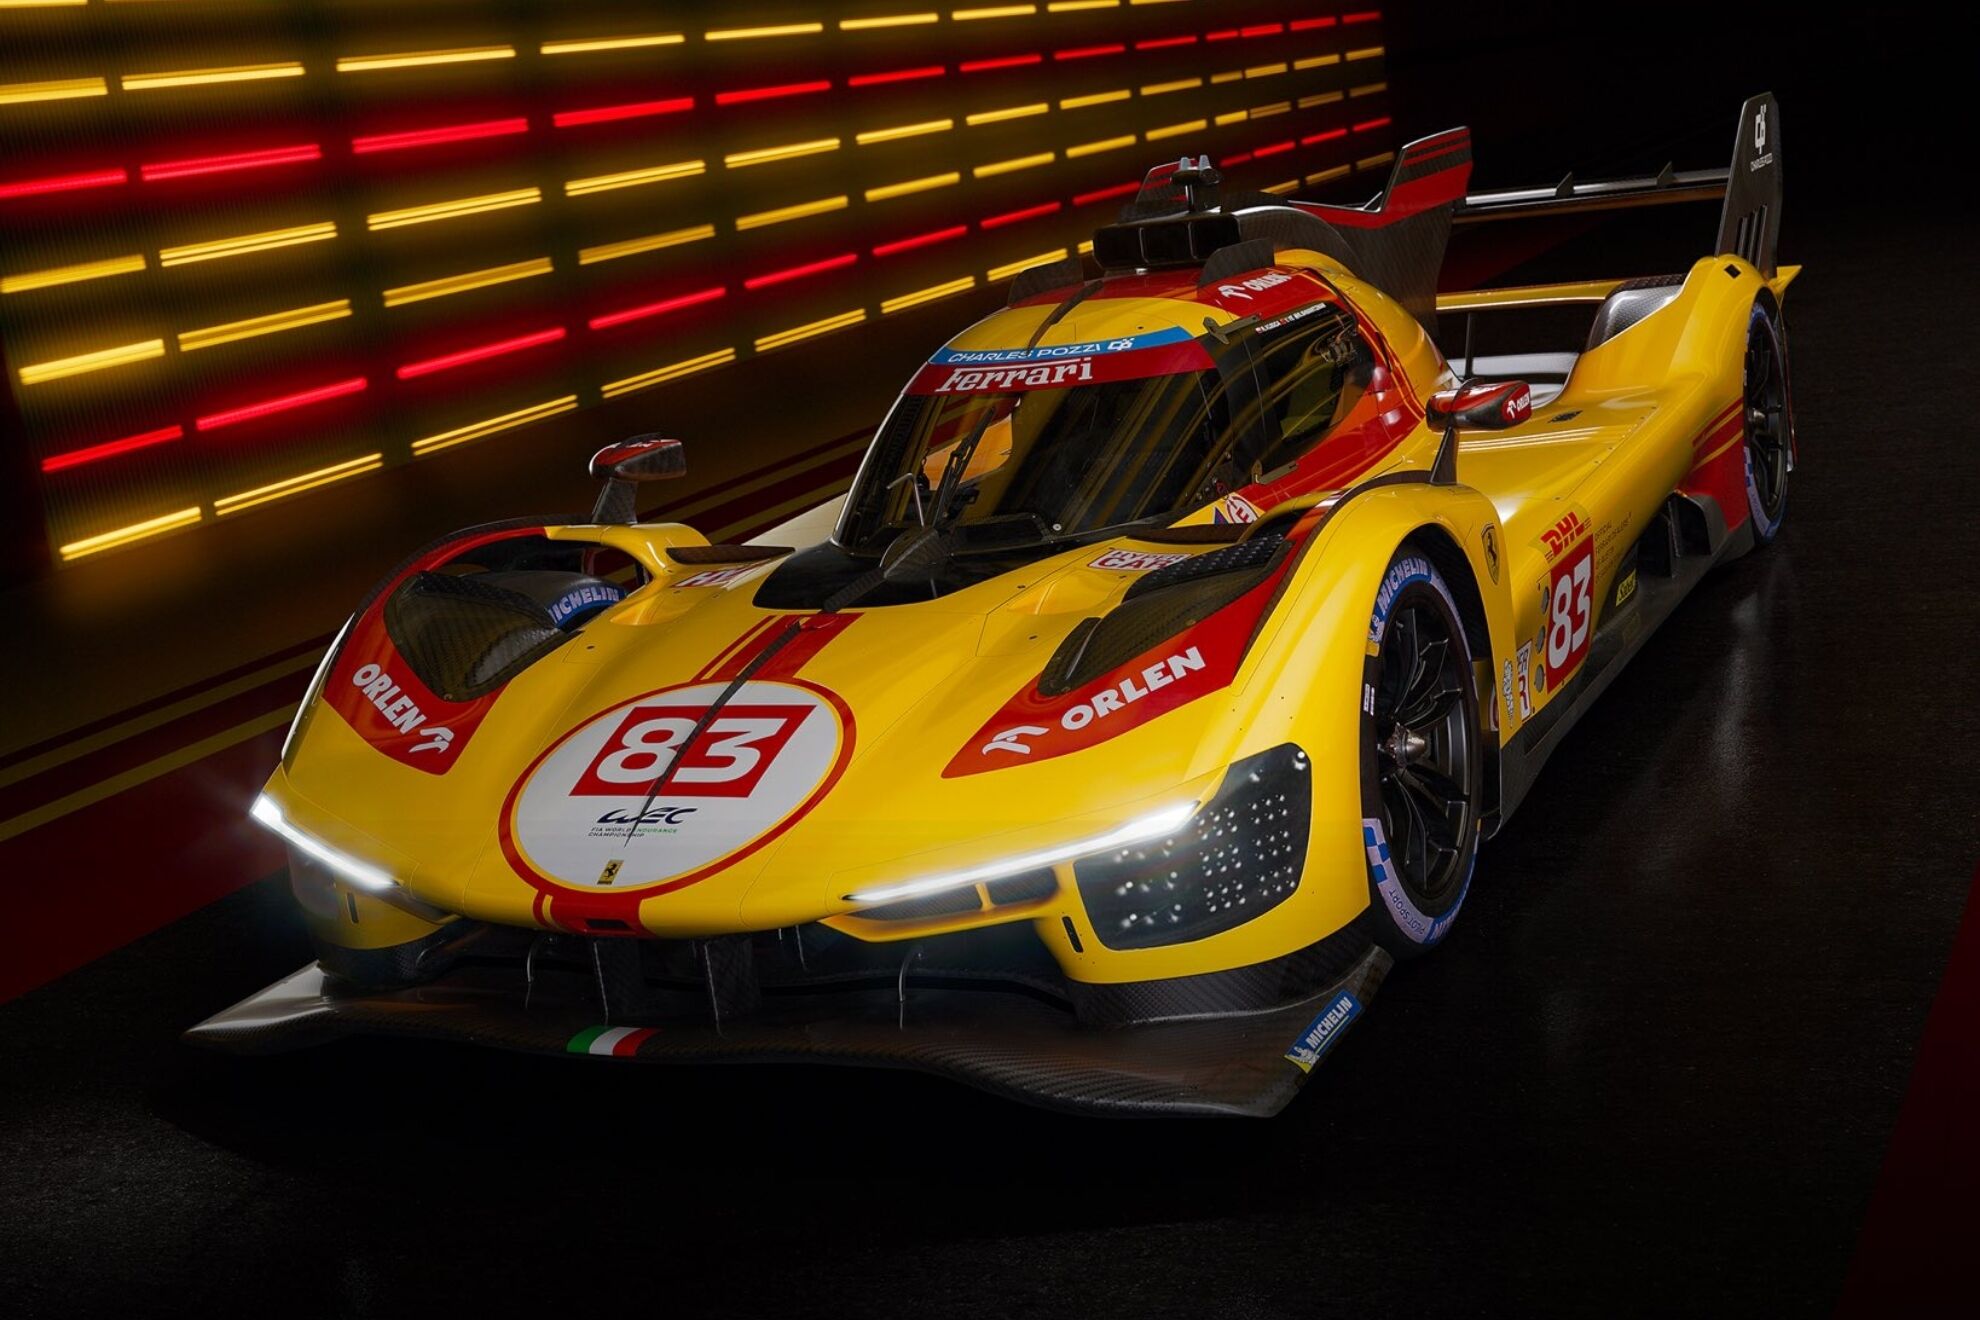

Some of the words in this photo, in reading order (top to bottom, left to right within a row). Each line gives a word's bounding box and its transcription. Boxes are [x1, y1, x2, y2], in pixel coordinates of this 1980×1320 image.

[934, 357, 1093, 393] Ferrari
[947, 350, 1034, 363] CHARLES
[1036, 343, 1100, 358] POZZI
[1540, 511, 1587, 556] DHL
[1098, 557, 1174, 569] CAR
[1376, 557, 1430, 616] MICHELIN
[1549, 553, 1592, 669] 83
[352, 662, 428, 733] ORLEN
[1060, 646, 1206, 731] ORLEN
[596, 717, 787, 784] 83
[597, 806, 698, 825] WEC
[1388, 888, 1411, 920] SPORT
[1407, 917, 1426, 935] PILOT
[1305, 996, 1353, 1049] MICHELIN
